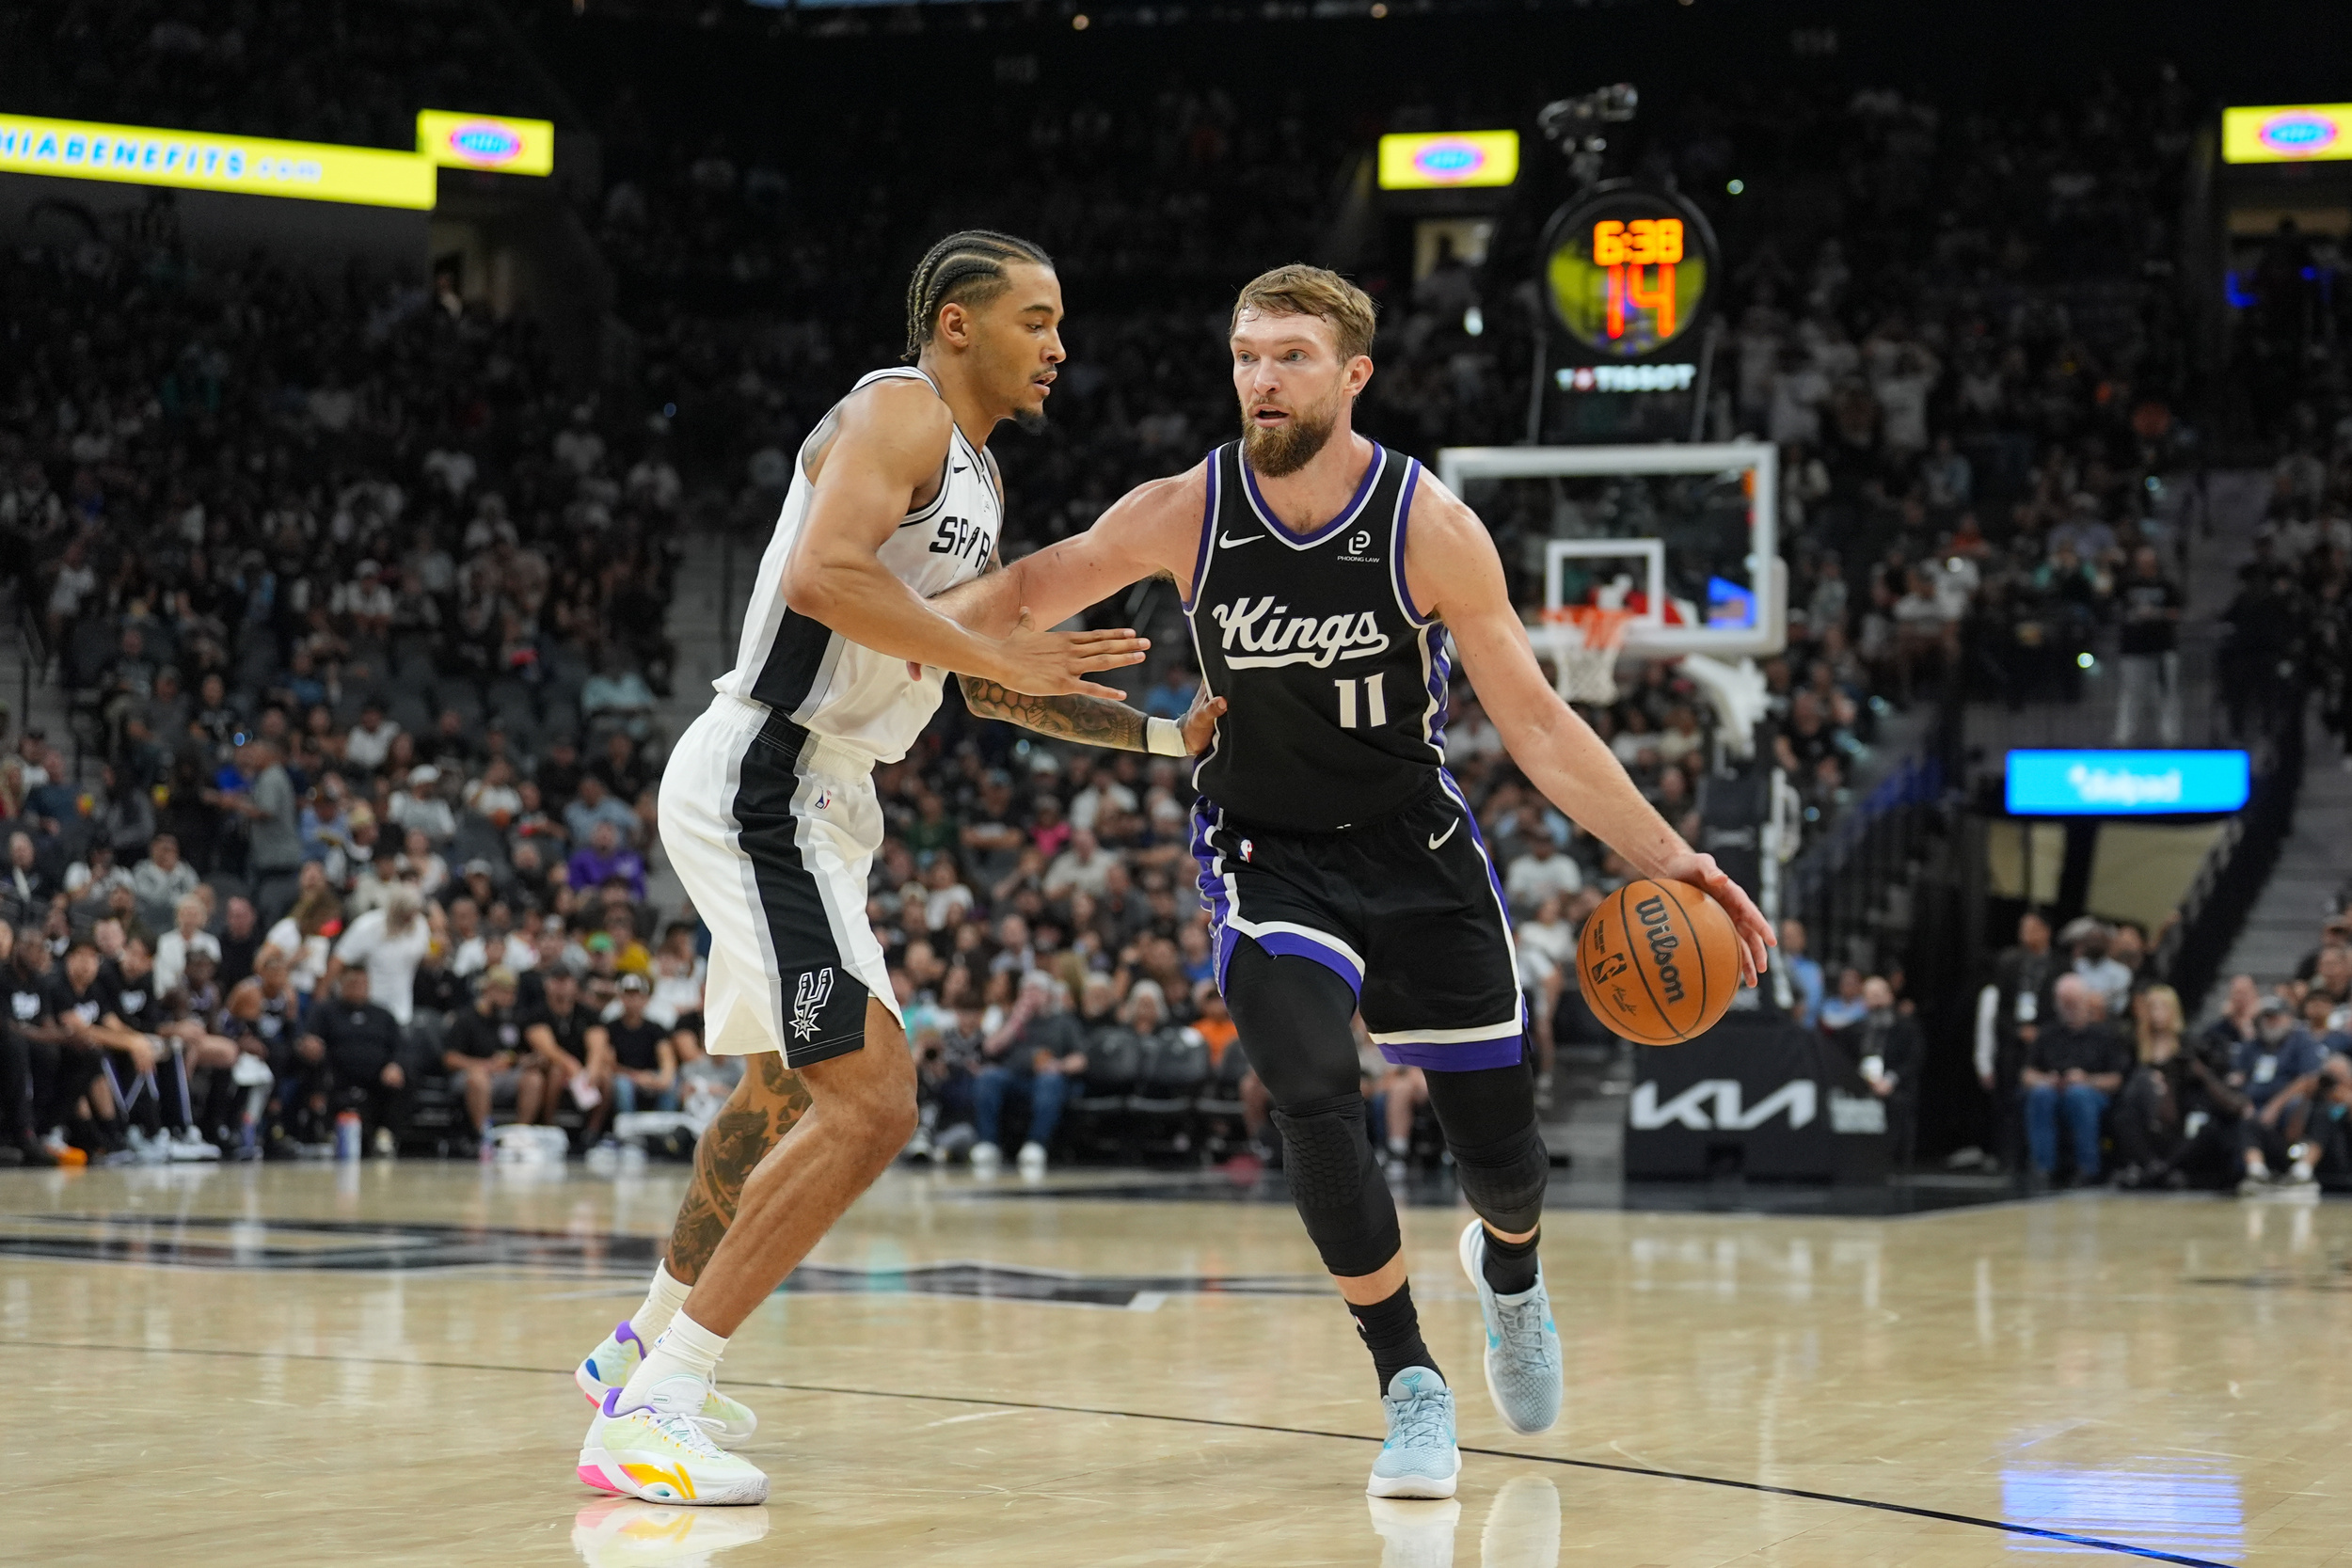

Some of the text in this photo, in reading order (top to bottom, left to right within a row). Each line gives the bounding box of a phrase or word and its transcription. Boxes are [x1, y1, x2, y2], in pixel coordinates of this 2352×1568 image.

[1594, 218, 1684, 266] 6:38
[1607, 262, 1676, 339] 14
[1212, 595, 1390, 669] Kings
[1334, 672, 1388, 729] 11
[1634, 894, 1686, 1006] Wilson
